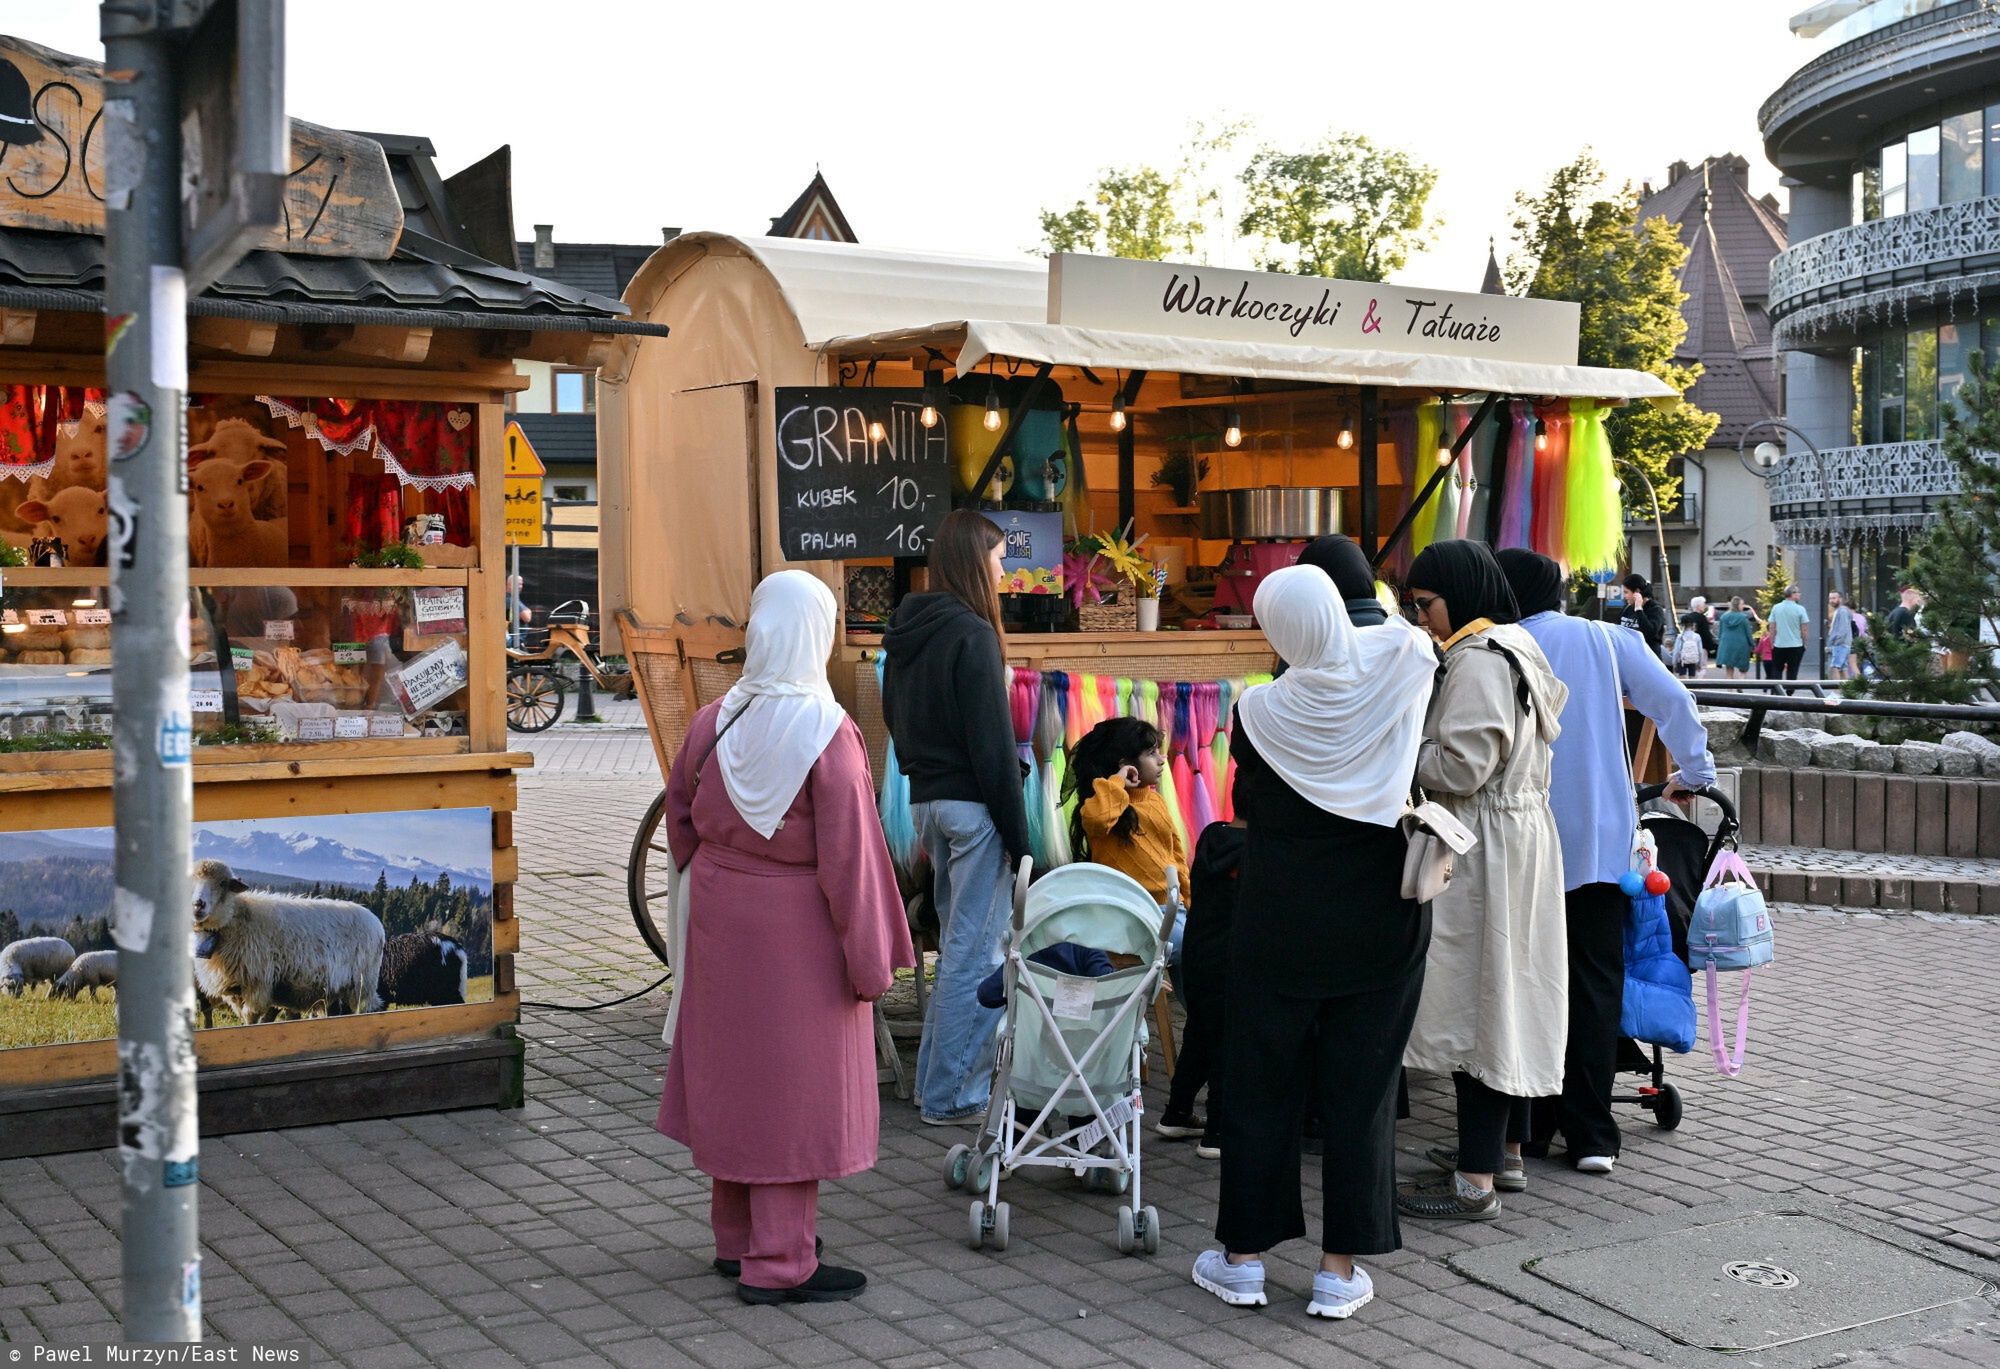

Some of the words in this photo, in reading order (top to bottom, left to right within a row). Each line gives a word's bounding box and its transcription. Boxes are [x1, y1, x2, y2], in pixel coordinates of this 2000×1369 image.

[1163, 274, 1341, 337] Warkoczyki
[1361, 298, 1381, 334] &
[1406, 299, 1500, 342] Tatuaże
[778, 401, 947, 470] GRANITA
[797, 486, 857, 507] KUBEK
[877, 475, 936, 512] 10,-
[801, 532, 857, 550] PALMA
[403, 658, 445, 688] PAKUJEMY
